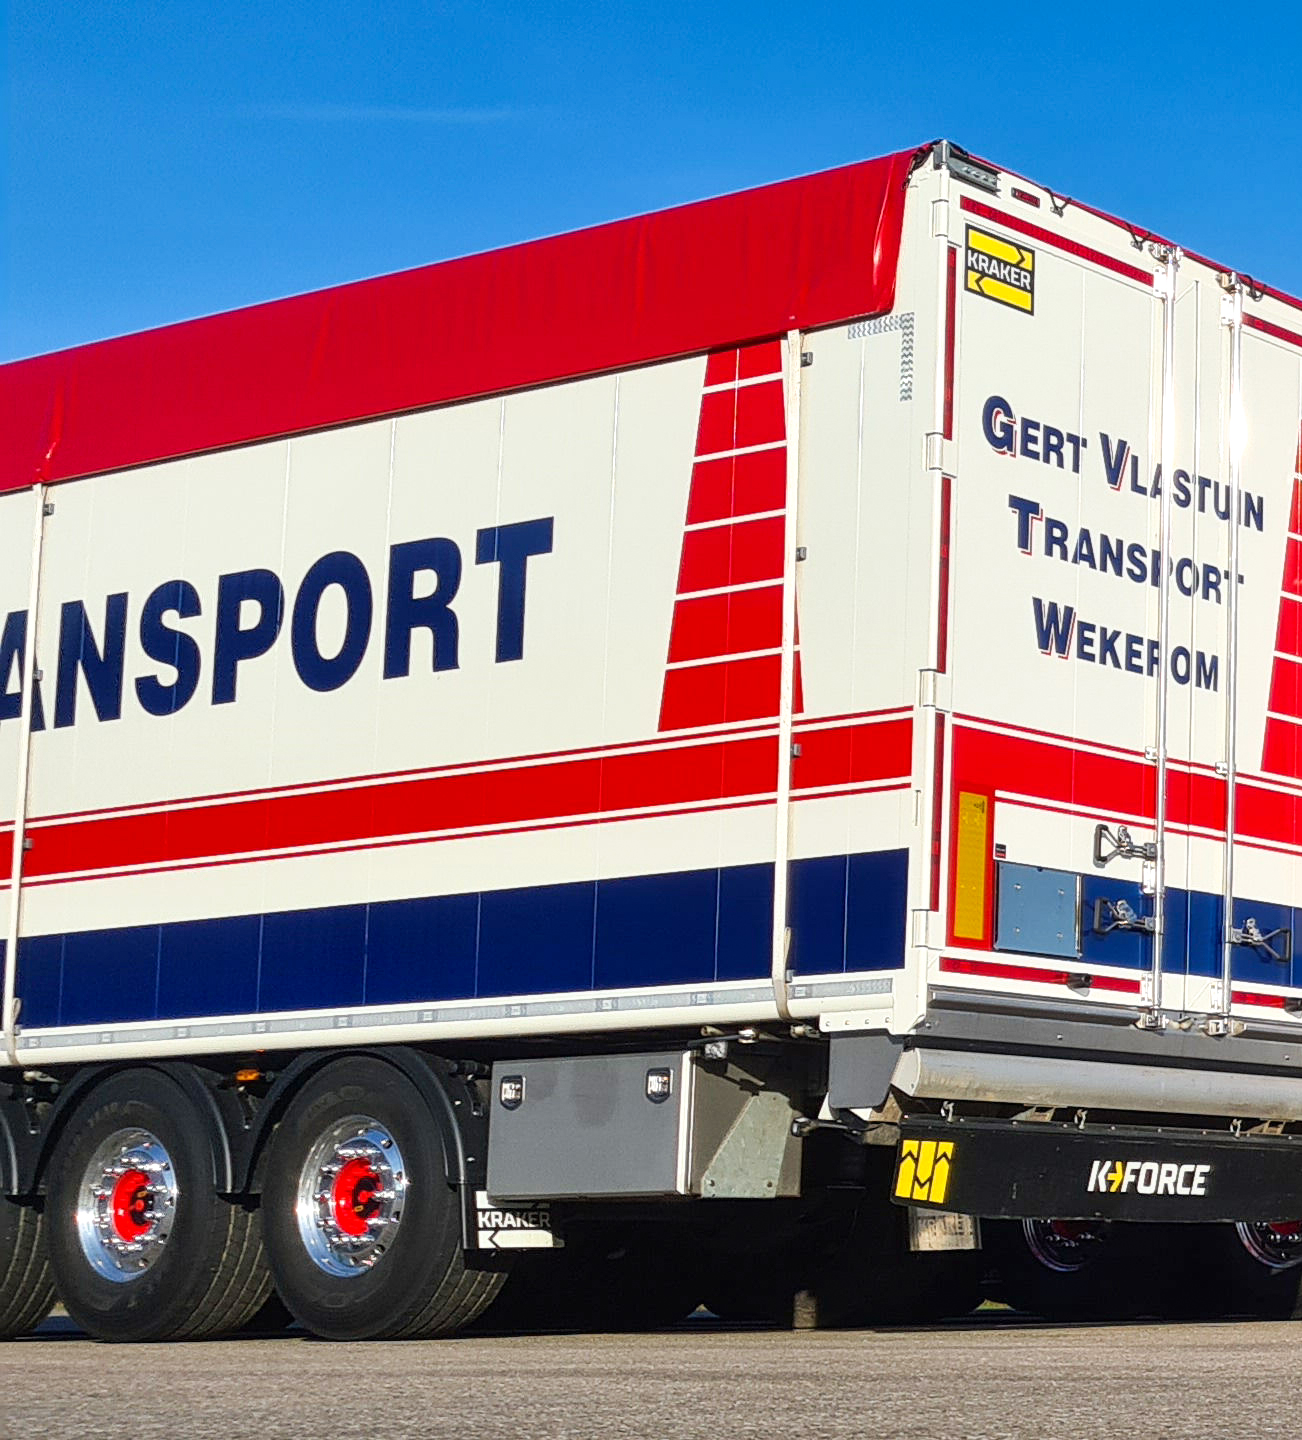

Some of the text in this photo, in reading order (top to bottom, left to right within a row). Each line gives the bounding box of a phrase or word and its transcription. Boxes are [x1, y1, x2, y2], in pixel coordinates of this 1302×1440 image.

[967, 249, 1032, 291] KRAKER
[982, 395, 1088, 475] GERT
[477, 1210, 551, 1228] KRAKER
